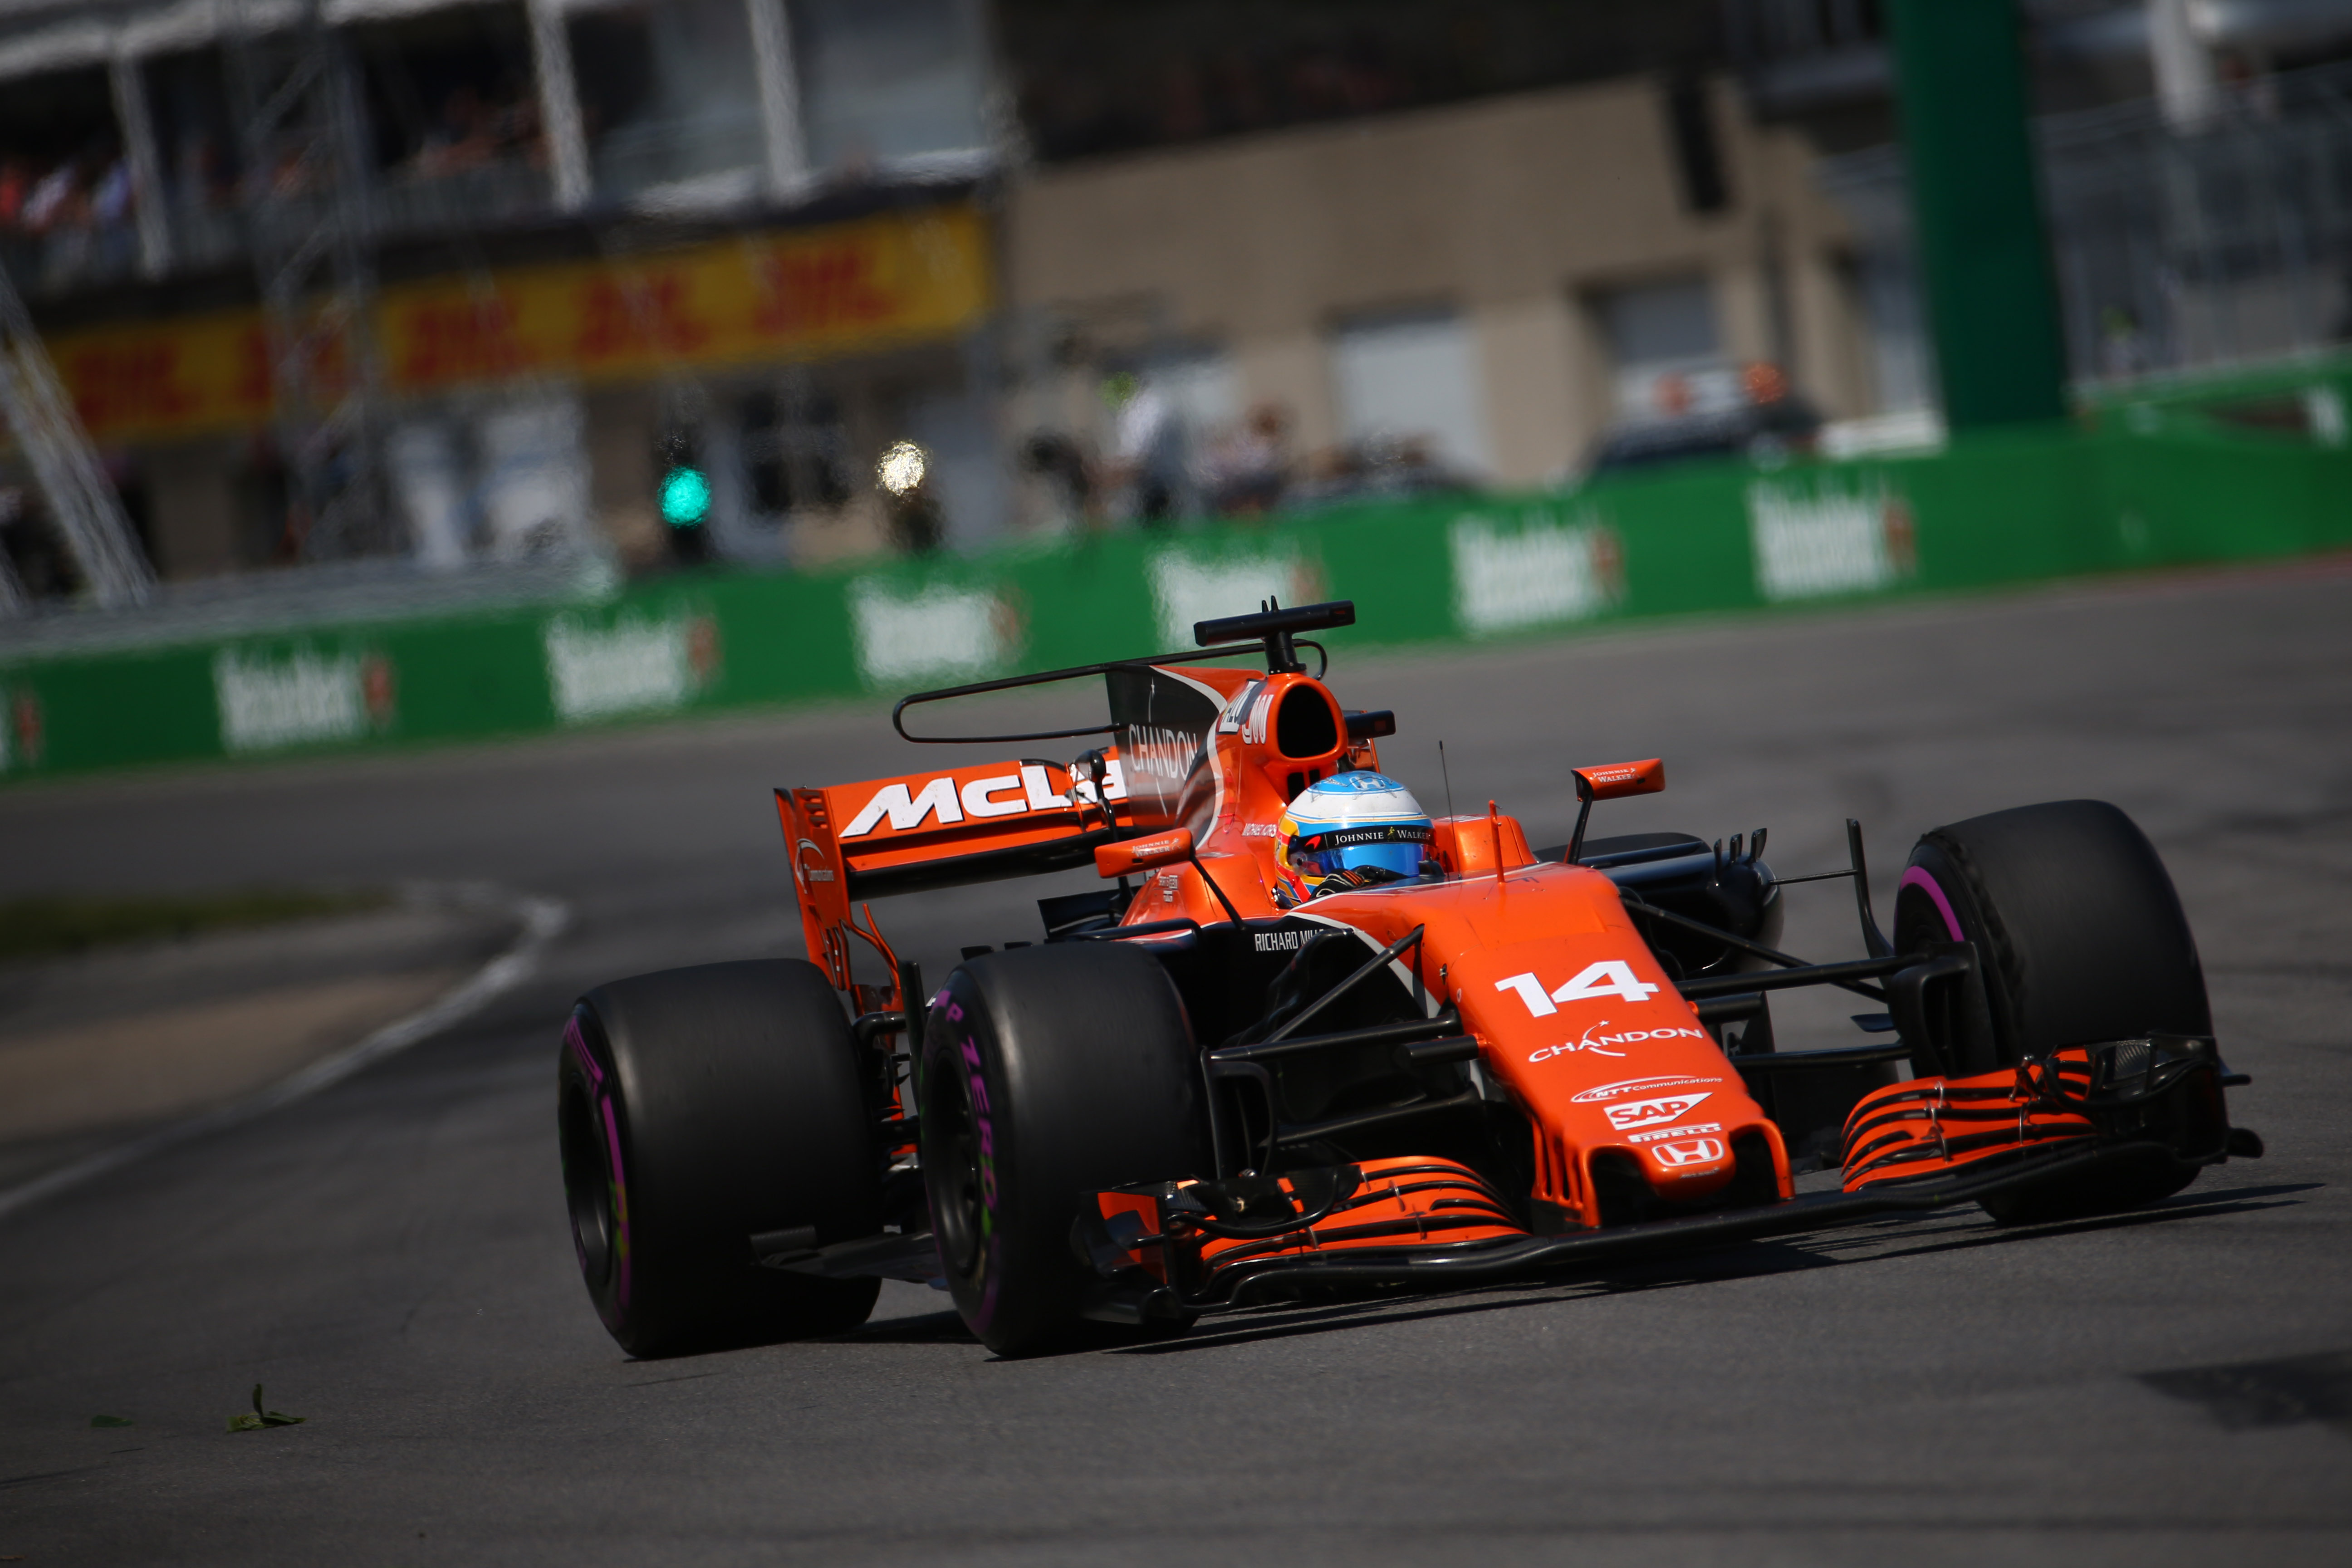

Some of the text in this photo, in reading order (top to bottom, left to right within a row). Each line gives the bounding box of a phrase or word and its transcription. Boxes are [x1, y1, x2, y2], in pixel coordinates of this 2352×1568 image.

[1592, 769, 1629, 778] JOHNNIE
[1597, 774, 1632, 783] WALKER
[1132, 840, 1170, 853] JOHNNIE
[1335, 829, 1431, 846] JOHNNIE WALKER
[1136, 846, 1170, 858] WALKER
[1254, 931, 1298, 951] RICHARD
[1494, 960, 1661, 1018] 14
[1528, 1027, 1704, 1063] CHANDON
[1610, 1101, 1689, 1124] SAP
[1627, 1122, 1722, 1143] PIRELLI
